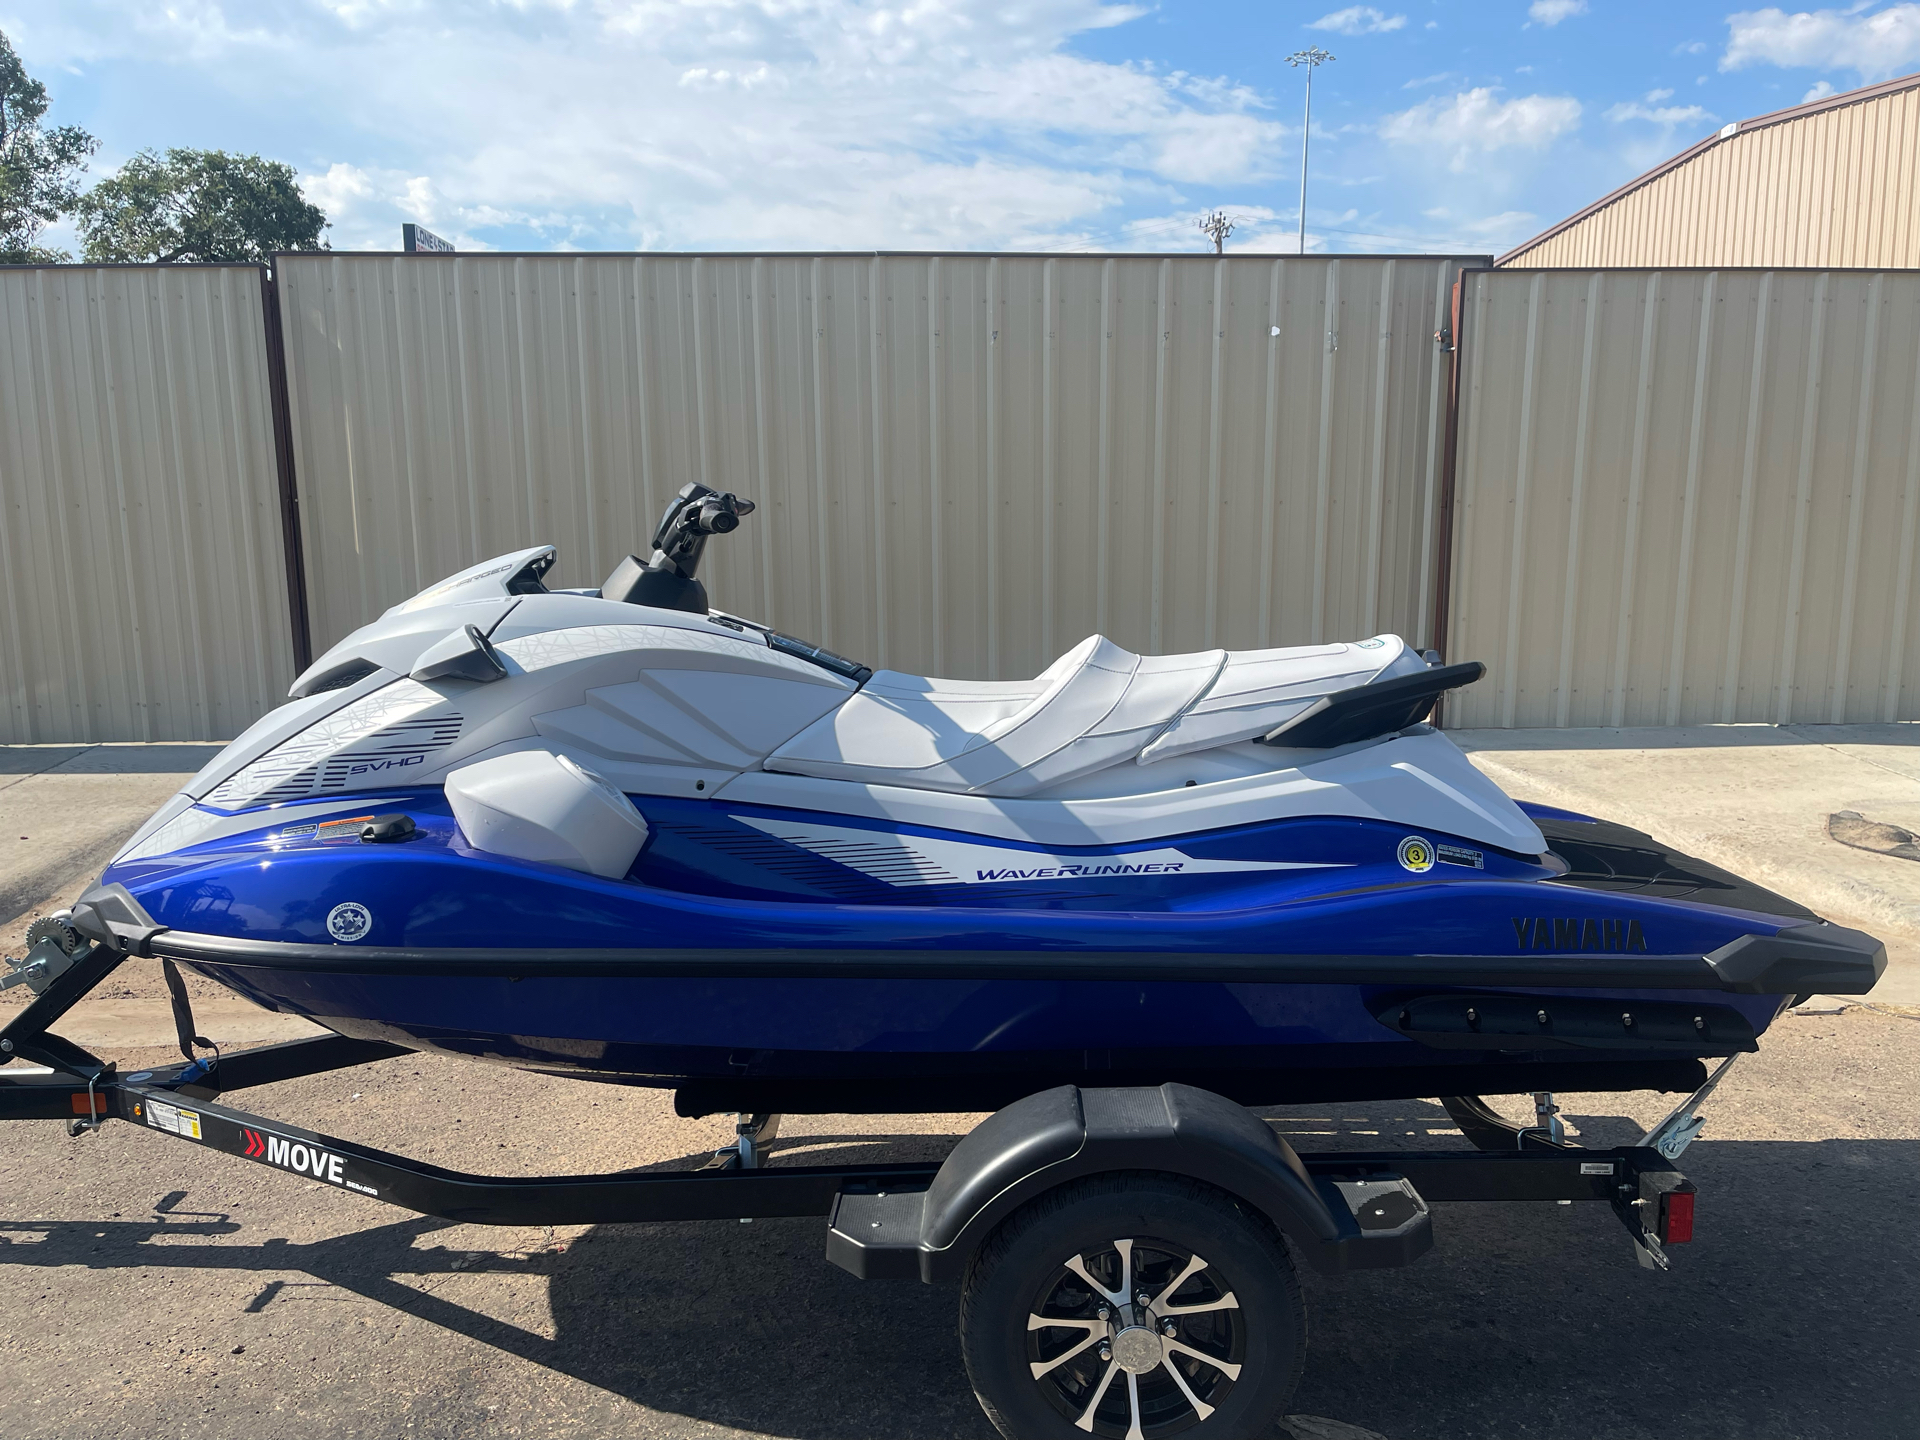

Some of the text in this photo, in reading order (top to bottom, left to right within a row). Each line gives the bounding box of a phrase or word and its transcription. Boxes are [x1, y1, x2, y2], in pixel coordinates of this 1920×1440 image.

[416, 227, 433, 250] LONE
[350, 755, 424, 775] SVHO
[1412, 849, 1420, 861] 3
[1511, 917, 1648, 951] YAMAHA
[267, 1135, 344, 1184] MOVE
